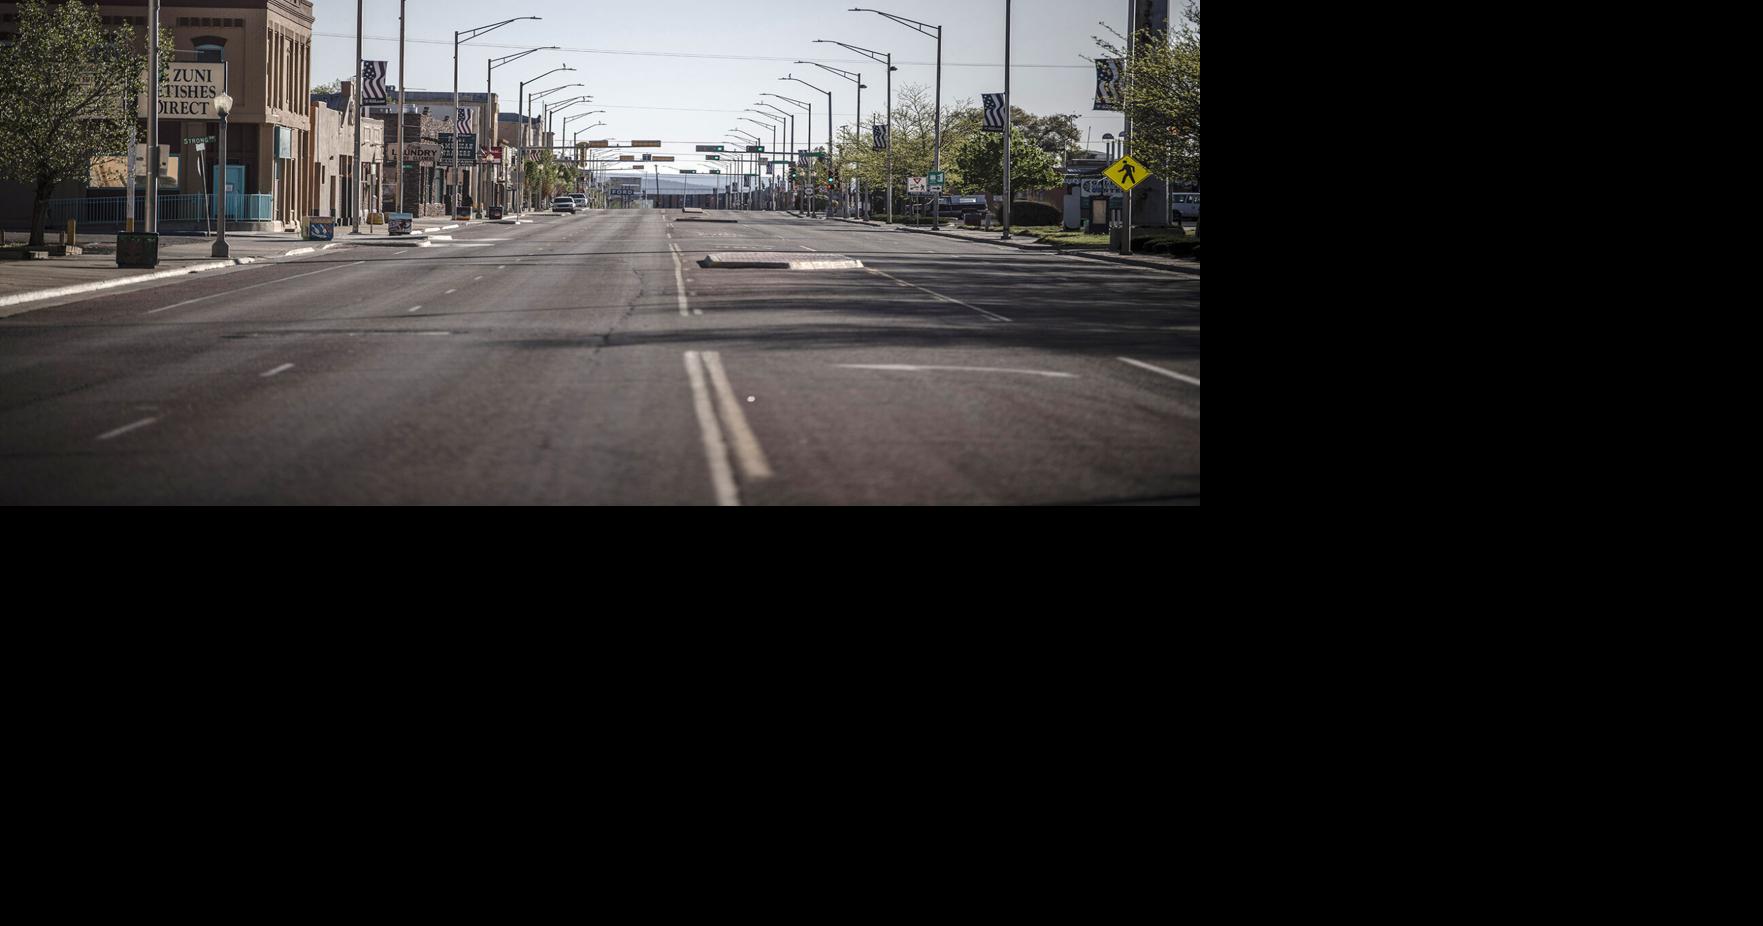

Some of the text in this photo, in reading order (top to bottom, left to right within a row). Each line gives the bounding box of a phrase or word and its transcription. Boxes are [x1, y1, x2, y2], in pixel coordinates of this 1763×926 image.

[173, 68, 213, 82] ZUNI
[157, 85, 216, 98] ETISHES
[183, 137, 209, 145] STRONG
